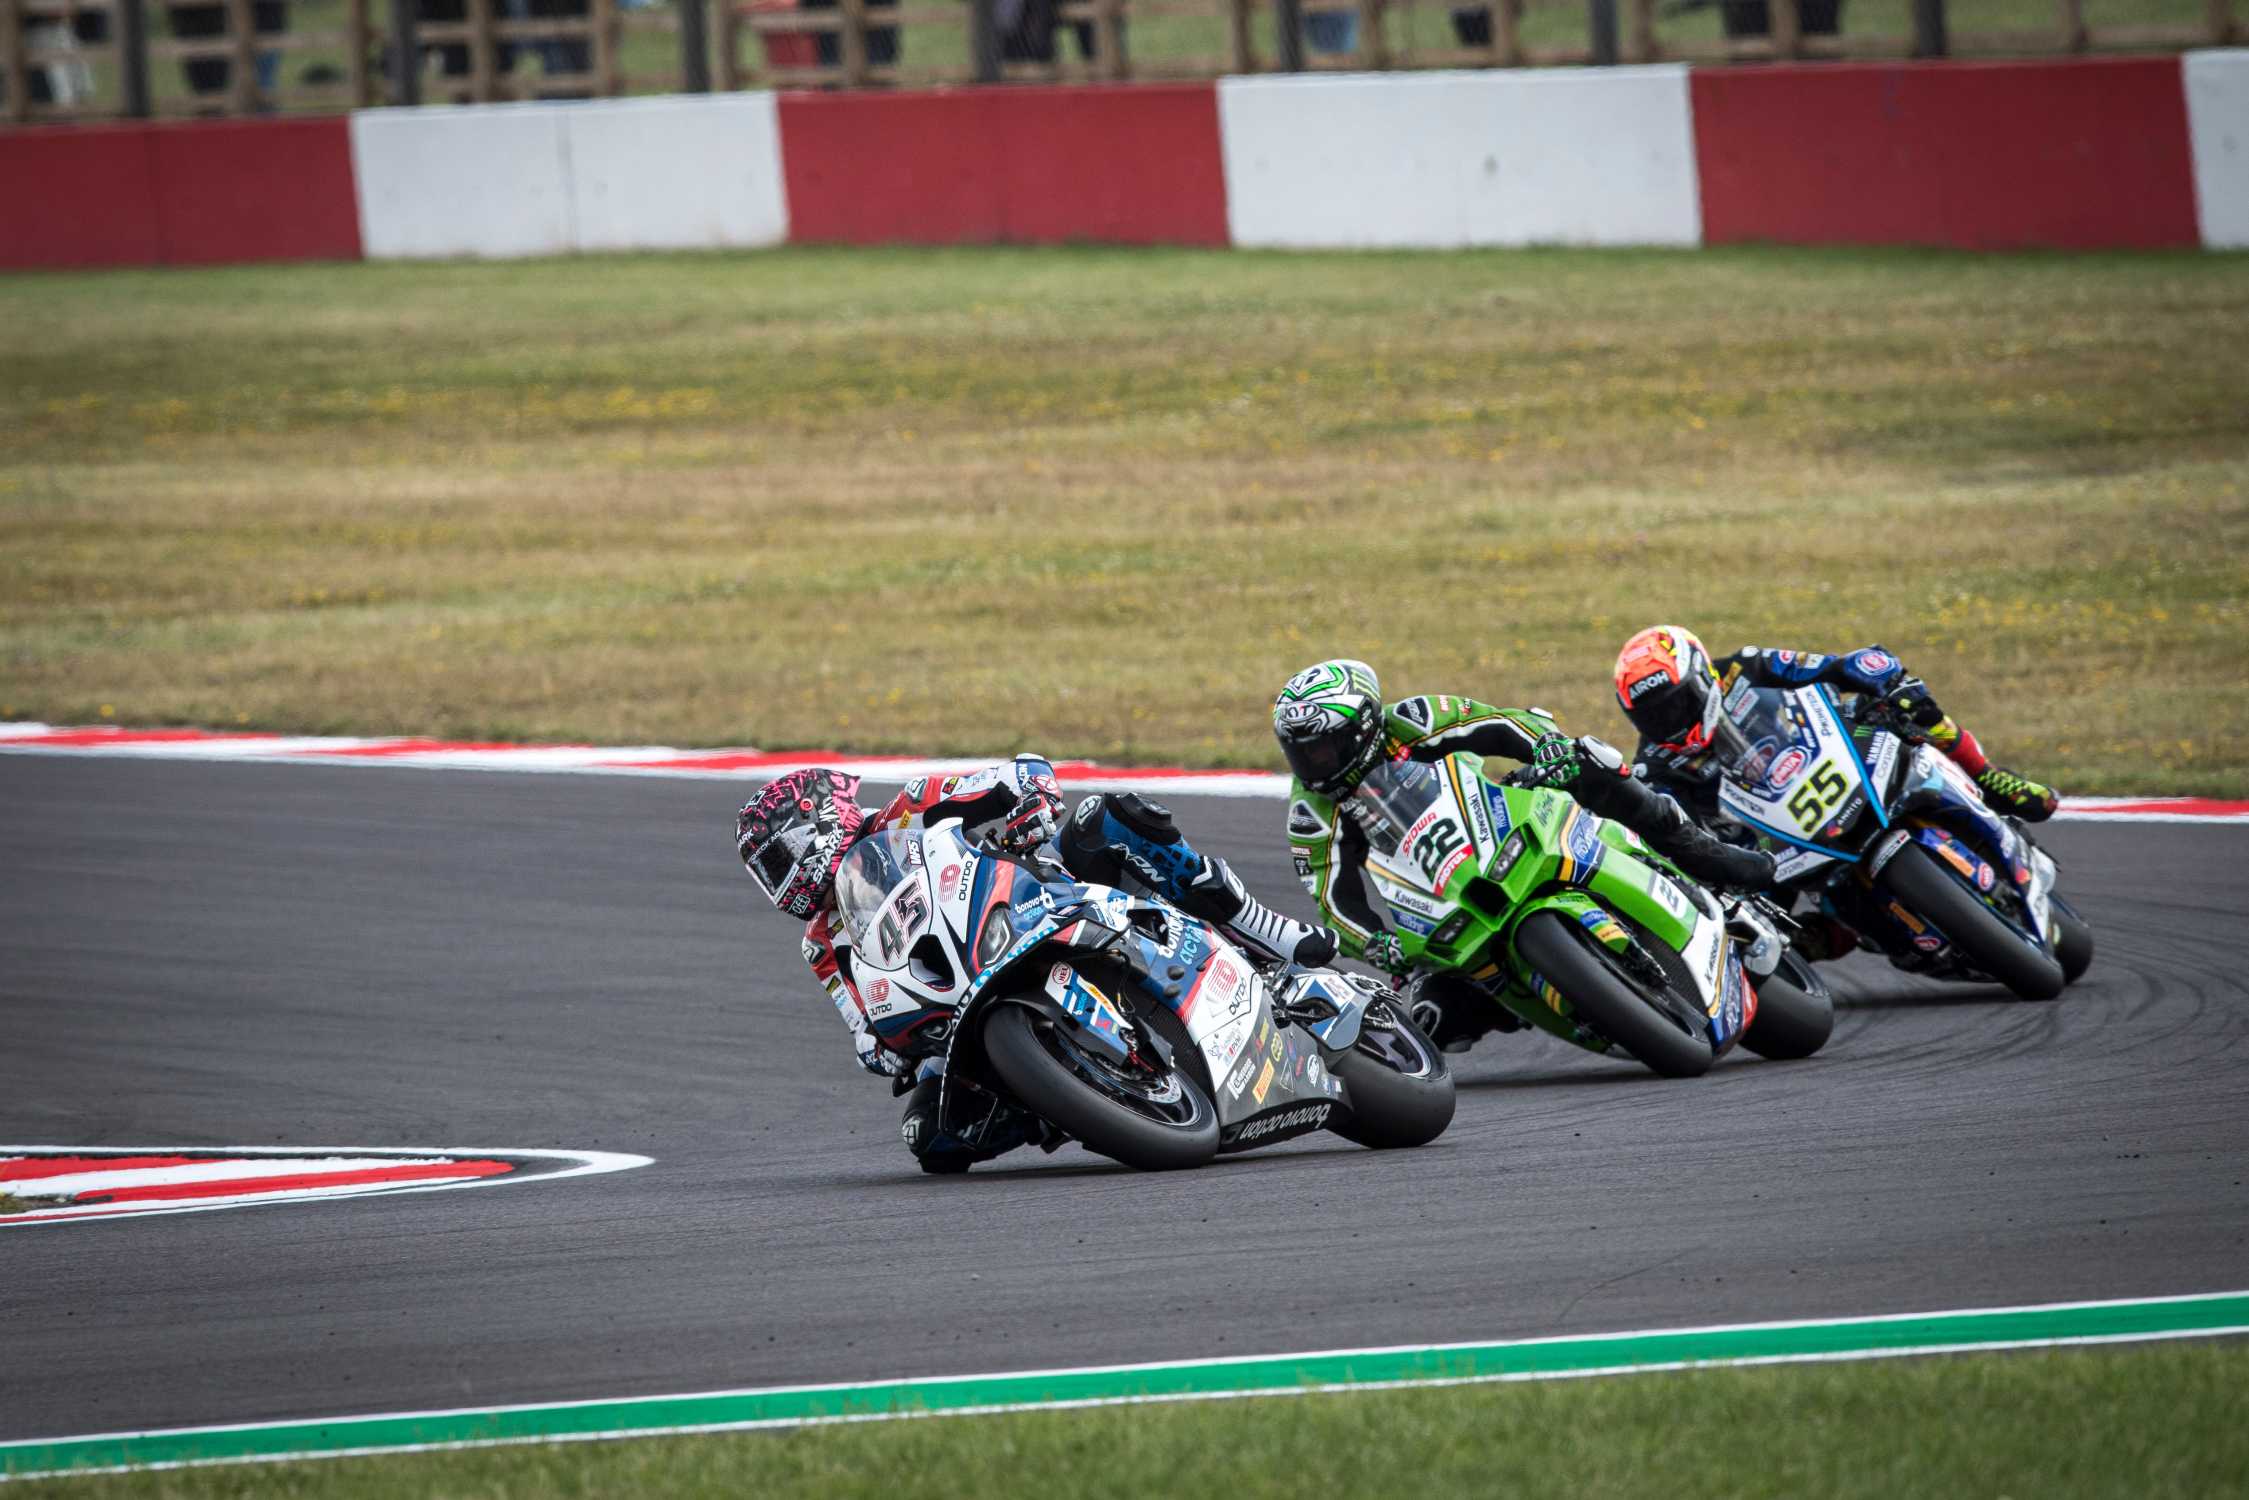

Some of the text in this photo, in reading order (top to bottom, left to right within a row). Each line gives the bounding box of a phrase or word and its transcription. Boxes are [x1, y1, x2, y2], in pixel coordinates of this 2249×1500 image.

[1630, 672, 1669, 699] AIROH
[1866, 731, 1887, 764] YAMAHA
[1787, 760, 1848, 833] 55
[1403, 812, 1437, 857] SHOWA
[1469, 793, 1491, 843] Kawasaki
[813, 822, 844, 885] SHARK
[908, 841, 922, 865] NHS
[1414, 818, 1465, 885] 22
[959, 860, 973, 901] OUTDO
[1014, 897, 1041, 914] bonovo
[1395, 889, 1434, 914] Kawasaki
[877, 879, 930, 967] 45
[1228, 977, 1247, 1015] OUTDO
[1240, 1114, 1282, 1140] action
